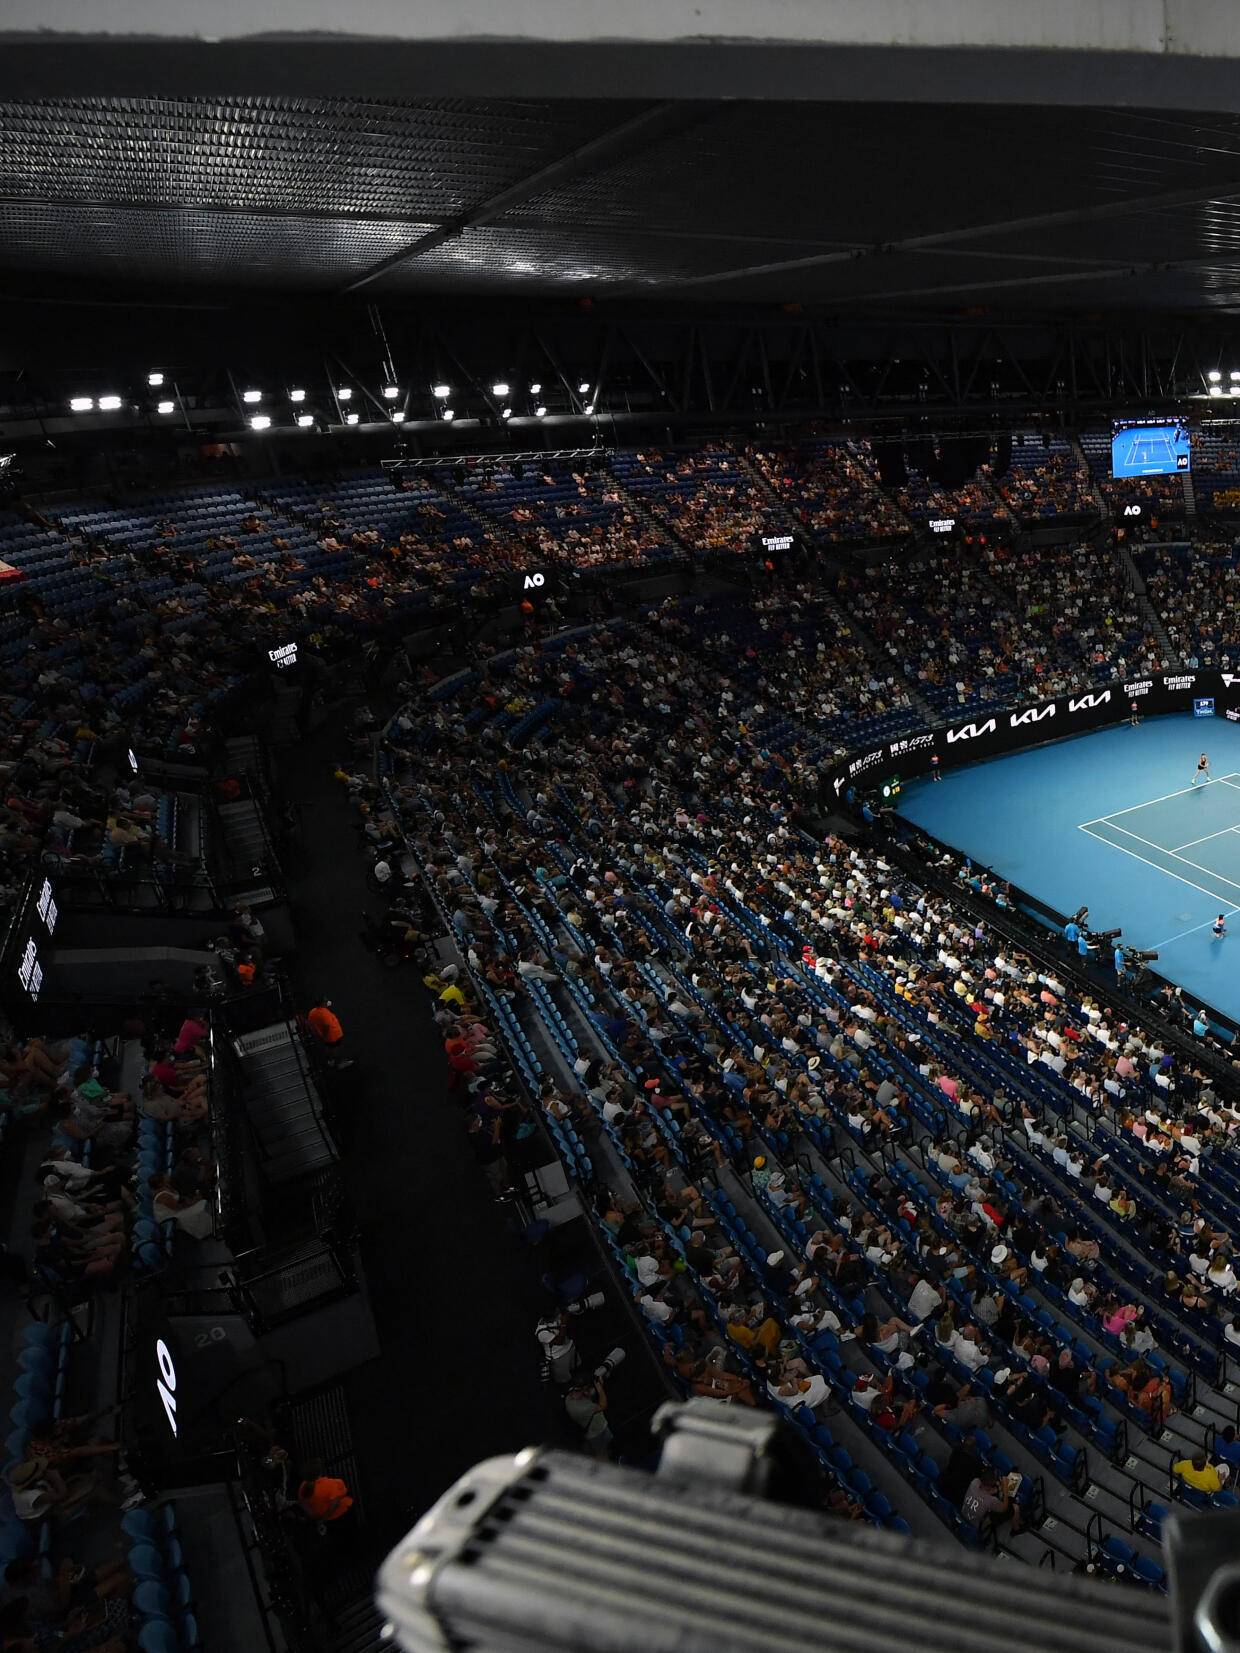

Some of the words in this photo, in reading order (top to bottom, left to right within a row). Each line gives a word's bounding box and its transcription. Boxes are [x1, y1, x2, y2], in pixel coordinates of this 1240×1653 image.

[1177, 457, 1188, 466] AO
[1124, 505, 1141, 515] AO
[524, 573, 545, 589] AO
[1163, 675, 1196, 685] Emirates
[157, 1339, 178, 1439] AO
